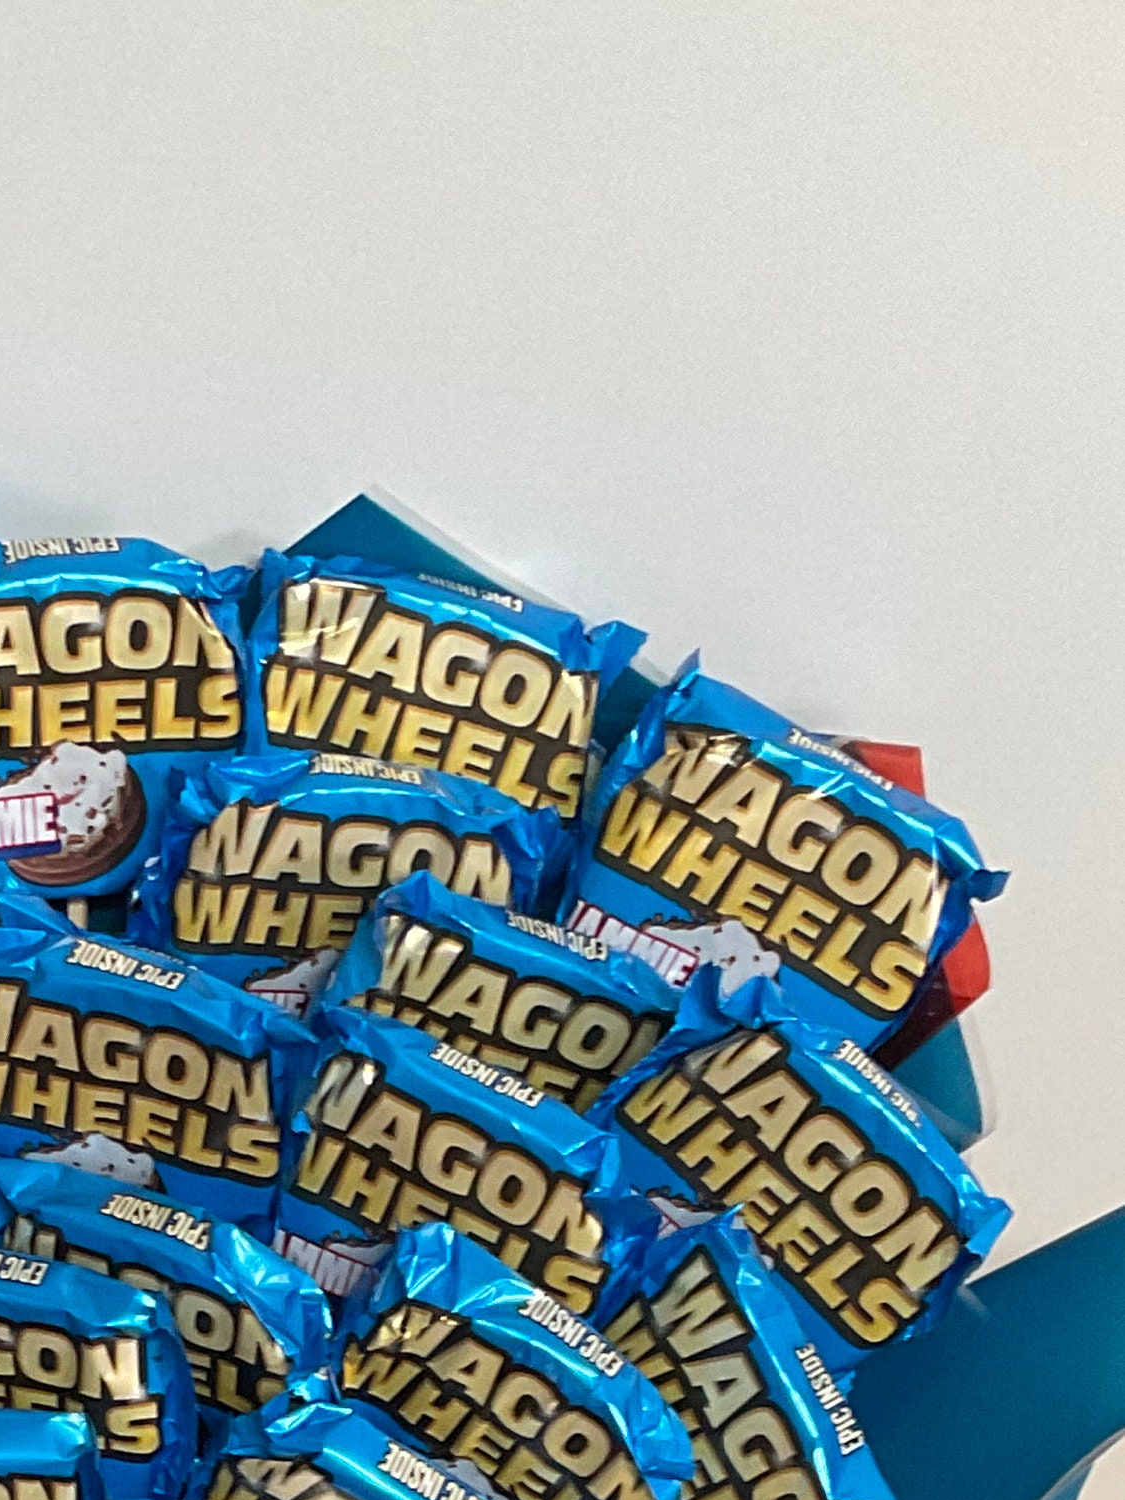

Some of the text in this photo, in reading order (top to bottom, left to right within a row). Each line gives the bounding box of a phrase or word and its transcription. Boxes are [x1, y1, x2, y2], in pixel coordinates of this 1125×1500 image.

[279, 579, 598, 747] WAGON
[266, 663, 586, 818] WHEELS
[190, 801, 511, 907] WAGON
[644, 727, 949, 951] WAGON
[505, 909, 609, 961] EPIC INSIDE
[601, 785, 927, 1012] WHEELS
[66, 939, 139, 977] INSIDE
[137, 964, 186, 991] EPIC
[430, 1042, 545, 1107] EPIC INSIDE
[304, 1055, 603, 1257] WAGON
[624, 1068, 920, 1343] WHEELS
[101, 1193, 173, 1231] INSIDE
[519, 1287, 624, 1378] EPIC INSIDE
[795, 1343, 865, 1456] EPIC INSIDE
